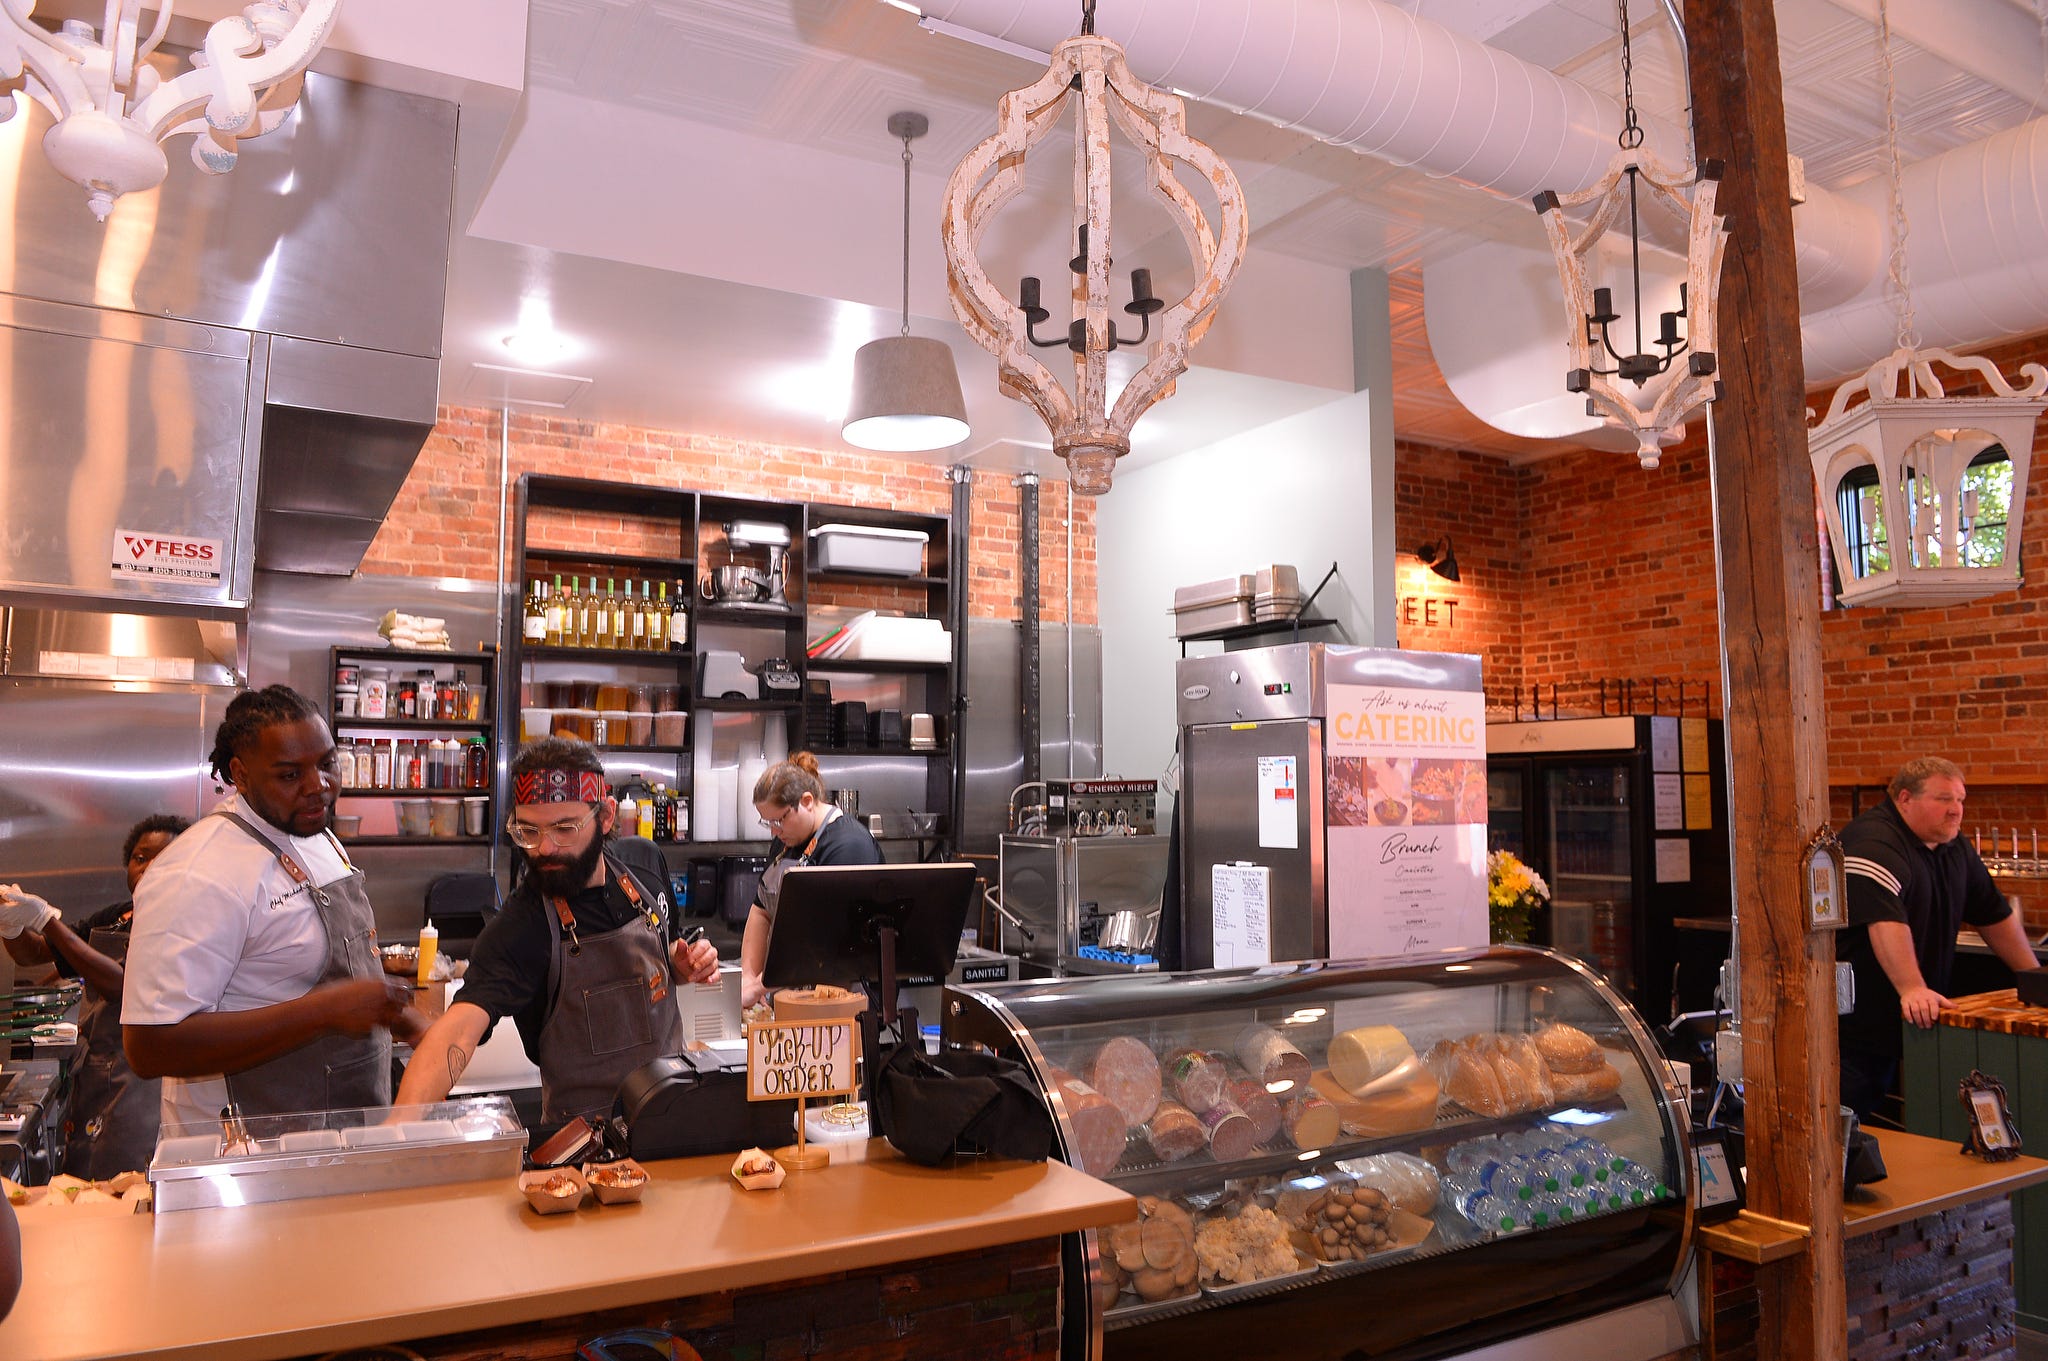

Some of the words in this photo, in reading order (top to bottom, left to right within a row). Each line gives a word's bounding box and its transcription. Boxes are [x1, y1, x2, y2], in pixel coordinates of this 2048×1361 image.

[155, 540, 214, 561] FESS
[171, 558, 213, 567] PROTECTION
[1396, 597, 1458, 628] EET
[1362, 690, 1394, 710] Ask
[1398, 699, 1410, 709] us
[1414, 697, 1455, 712] about
[1335, 712, 1475, 743] CATERING
[1088, 784, 1125, 794] ENERGY
[1127, 783, 1154, 792] MIZER
[1380, 832, 1442, 864] Brunch
[965, 967, 1006, 980] SANITIZE
[764, 1063, 835, 1095] ORDER
